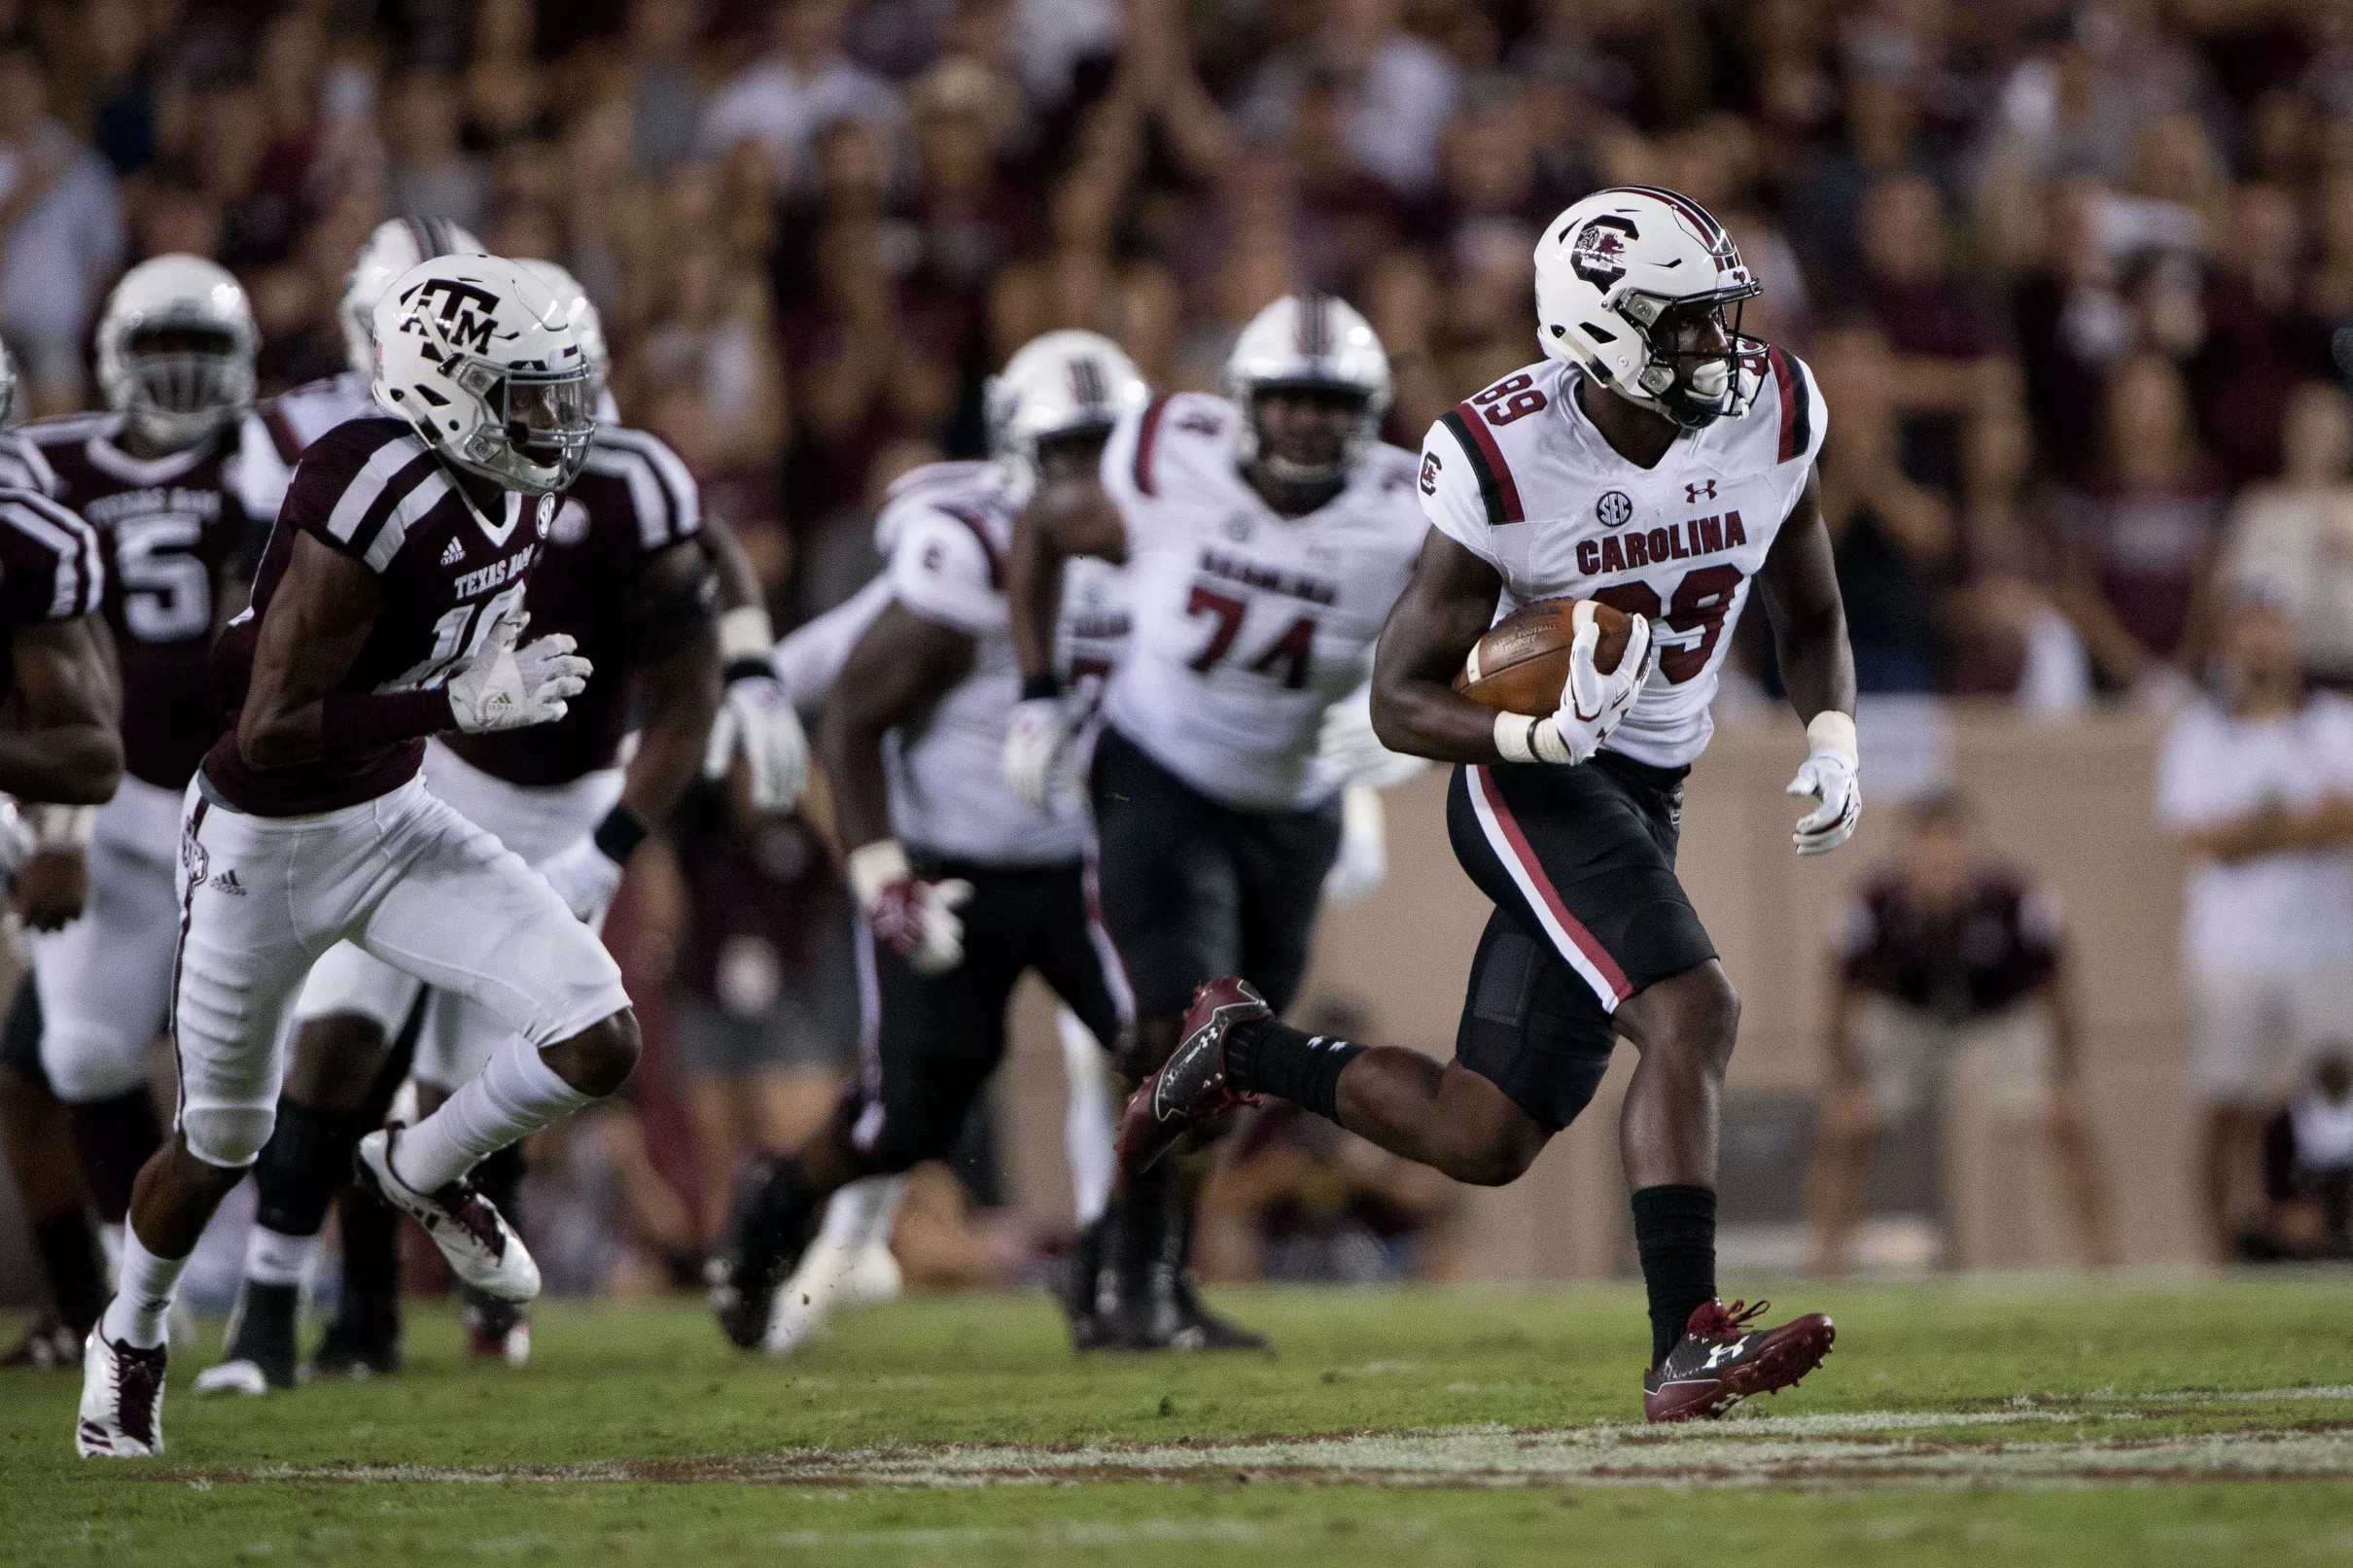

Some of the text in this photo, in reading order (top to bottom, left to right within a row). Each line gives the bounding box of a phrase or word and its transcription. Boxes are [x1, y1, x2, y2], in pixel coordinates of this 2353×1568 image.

[1472, 373, 1548, 426] 89
[1597, 491, 1633, 527] SEC
[1576, 509, 1747, 575] CAROLINA
[115, 513, 210, 643] 5
[454, 559, 507, 600] TEXAS
[1184, 585, 1317, 689] 74
